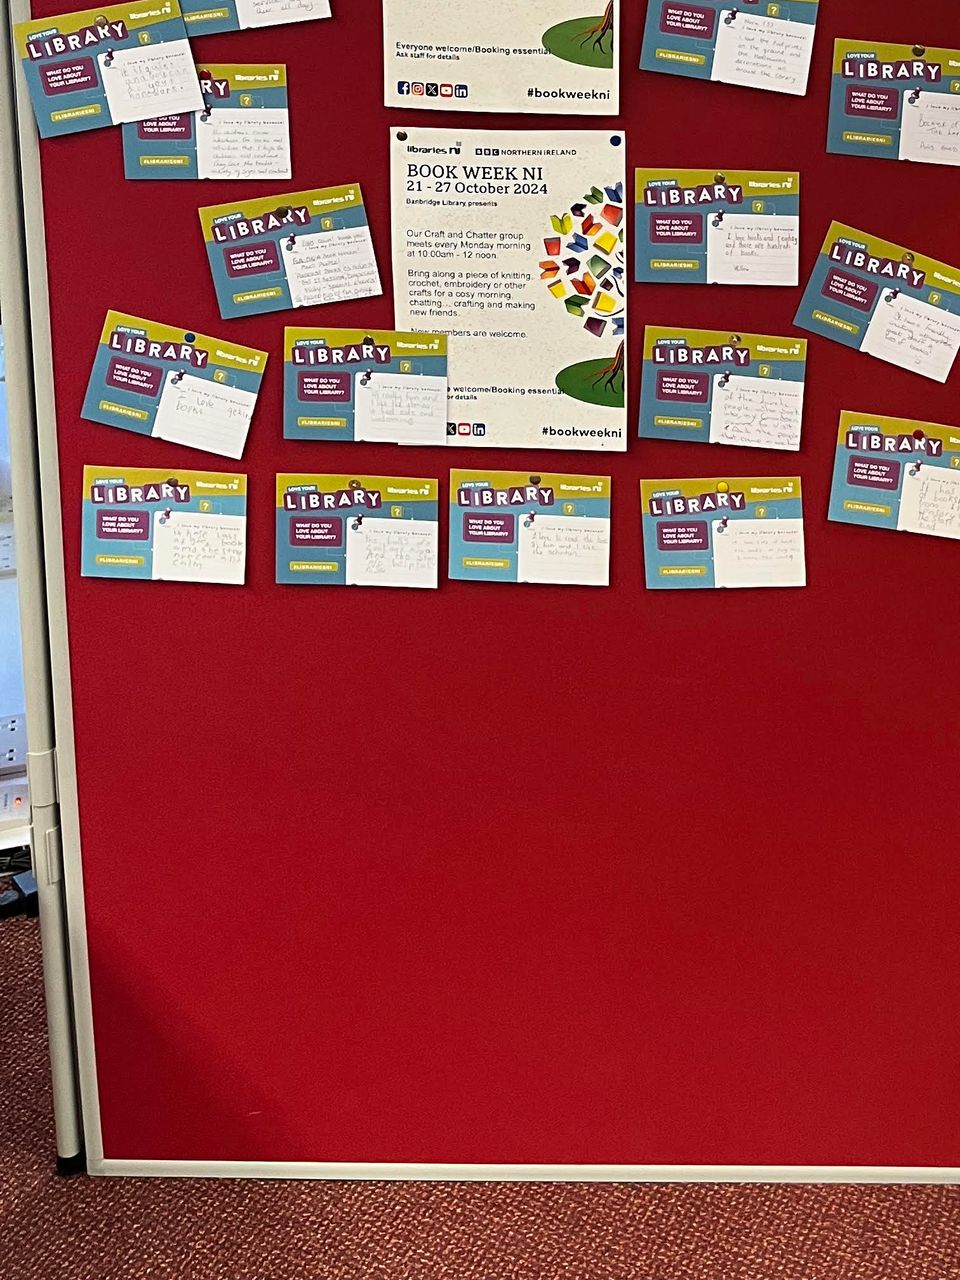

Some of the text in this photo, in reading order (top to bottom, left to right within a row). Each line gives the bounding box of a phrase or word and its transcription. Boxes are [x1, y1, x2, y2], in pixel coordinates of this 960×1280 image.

[28, 22, 125, 58] LIBRARY
[396, 42, 433, 52] Everyone
[844, 61, 940, 80] LIBRARY
[527, 88, 610, 100] #bookweekni
[407, 145, 447, 155] libraries
[407, 164, 543, 180] BOOK WEEK NI
[407, 181, 548, 194] 21 27 October 2024
[646, 184, 741, 205] LIBRARY
[406, 198, 441, 206] Banbridge
[442, 199, 466, 207] Library
[215, 209, 307, 242] LIBRARY
[424, 230, 445, 238] Craft
[466, 231, 497, 239] Chatter
[500, 233, 524, 241] group
[435, 242, 457, 250] every
[460, 241, 493, 250] Monday
[497, 243, 531, 251] morning
[408, 269, 430, 278] Bring
[432, 270, 455, 279] along
[466, 271, 488, 279] piece
[831, 245, 924, 286] LIBRARY
[444, 281, 491, 290] embroidery
[454, 300, 484, 309] crafting
[505, 302, 535, 311] making
[111, 334, 208, 365] LIBRARY
[294, 344, 388, 364] LIBRARY
[654, 346, 748, 365] LIBRARY
[542, 426, 622, 438] #bookweekni
[848, 433, 941, 454] LIBRARY
[93, 483, 188, 503] LIBRARY
[286, 491, 380, 510] LIBRARY
[459, 487, 552, 506] LIBRARY
[651, 493, 744, 515] LIBRARY
